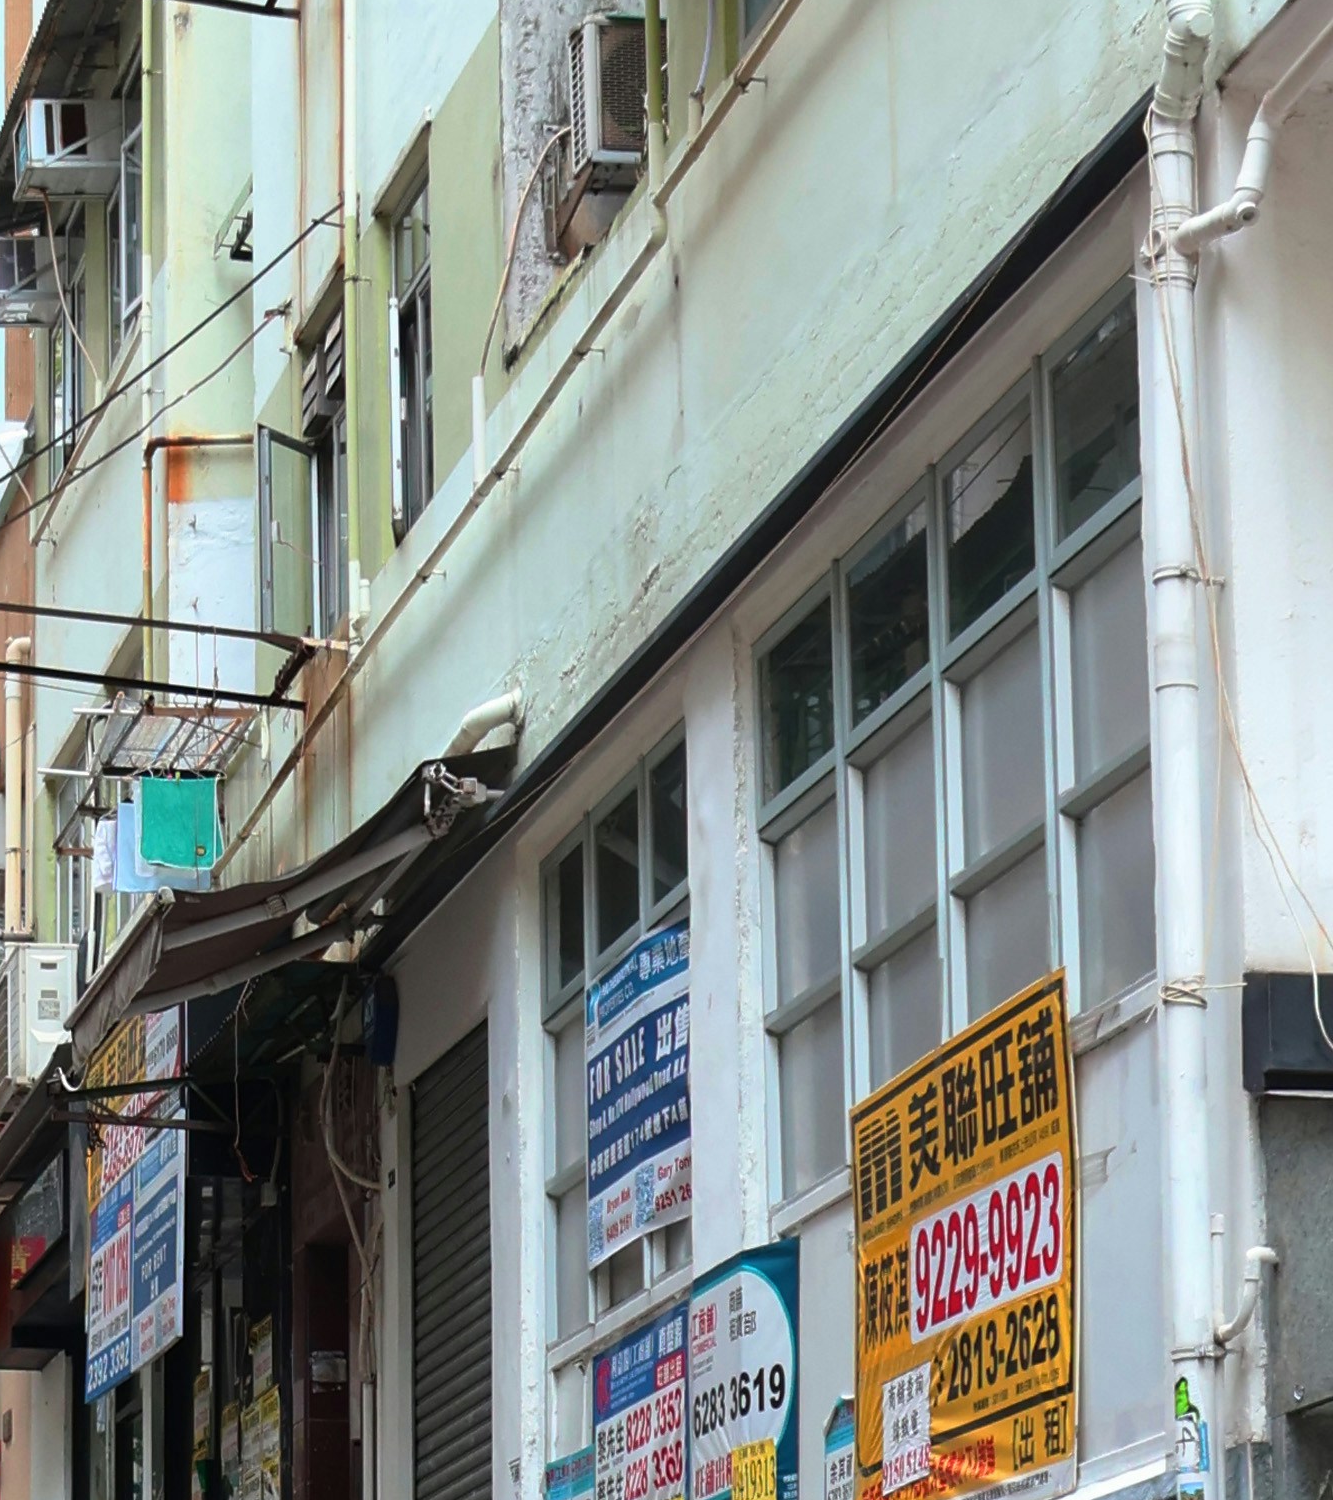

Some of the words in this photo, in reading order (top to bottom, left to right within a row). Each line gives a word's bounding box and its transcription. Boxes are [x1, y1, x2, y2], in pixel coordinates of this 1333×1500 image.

[590, 1054, 611, 1105] FOR
[615, 1026, 645, 1085] SALE
[655, 1001, 690, 1062] 出售
[908, 1005, 1059, 1192] 美聯旺舖
[655, 1189, 677, 1213] 9251
[657, 1164, 673, 1181] Gary
[915, 1162, 1061, 1333] 9229-9923
[87, 1354, 108, 1394] 2392
[947, 1293, 1061, 1402] 2813-2628
[626, 1403, 652, 1454] 8228
[653, 1387, 682, 1438] 3553
[693, 1382, 726, 1438] 6283
[729, 1363, 786, 1422] 3619
